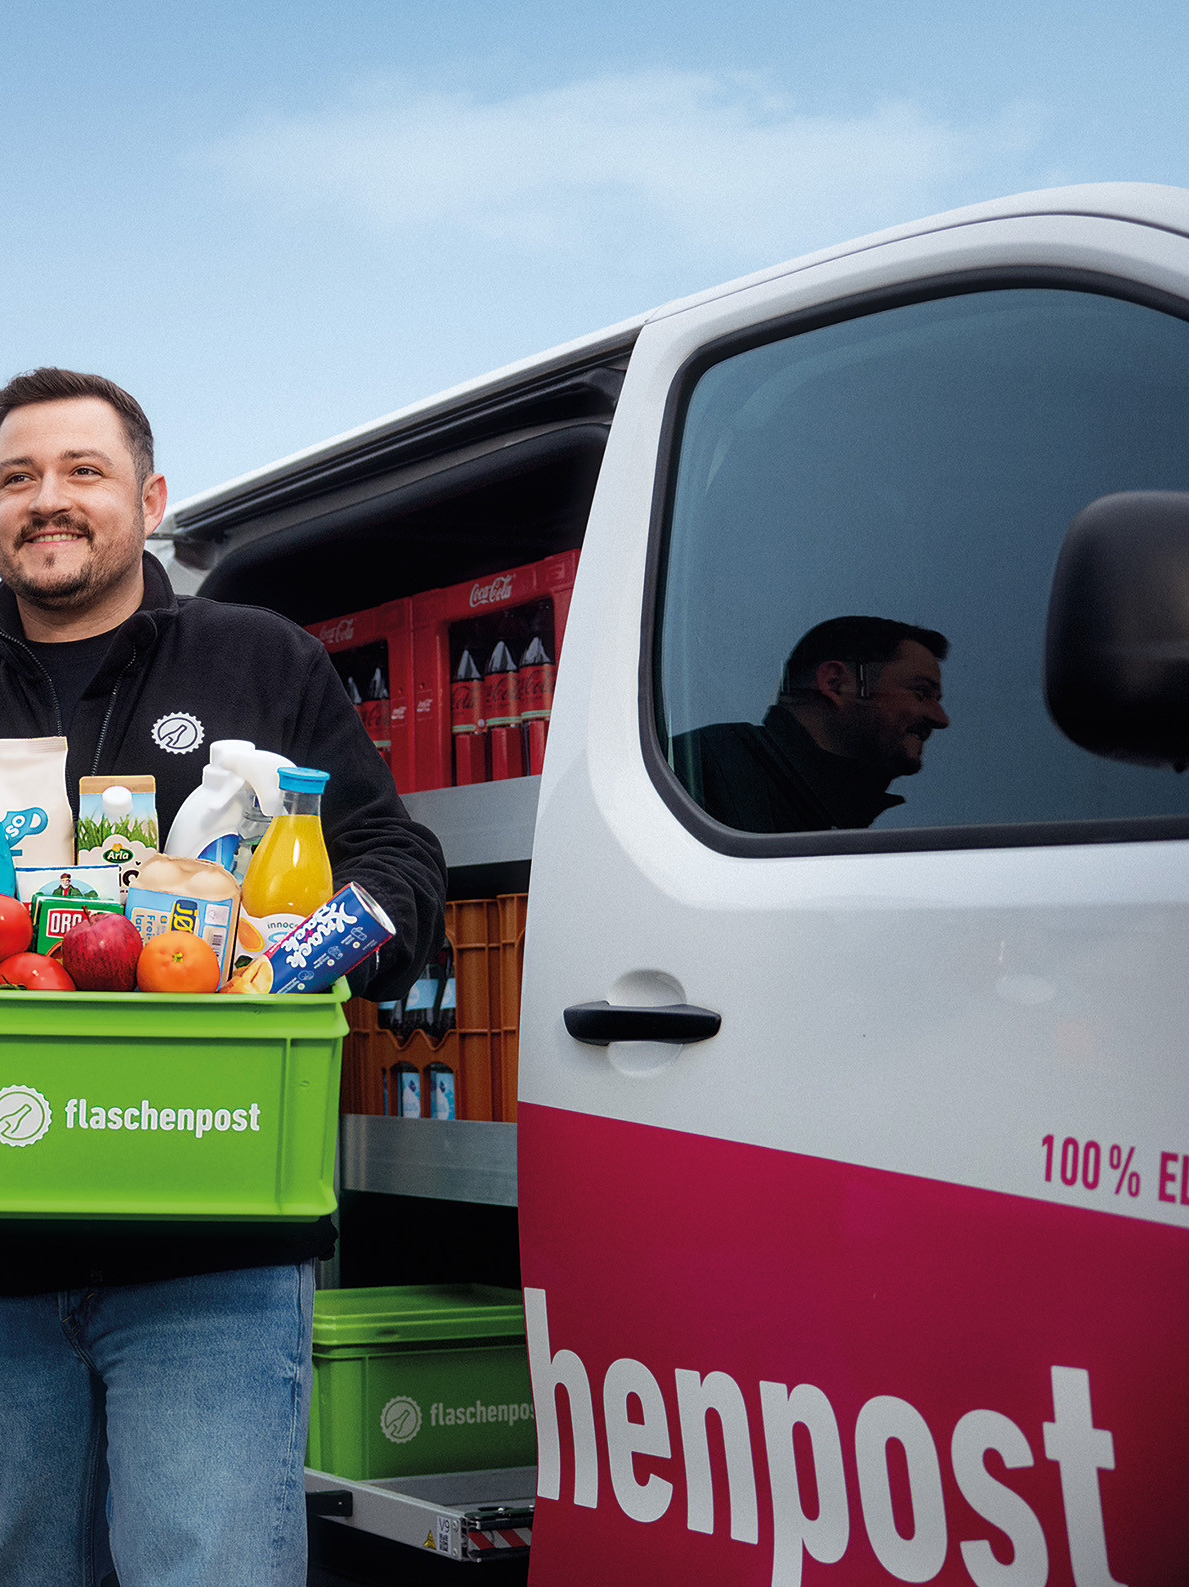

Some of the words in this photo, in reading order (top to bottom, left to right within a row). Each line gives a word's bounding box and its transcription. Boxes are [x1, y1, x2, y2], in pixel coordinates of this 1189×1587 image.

[469, 576, 515, 608] Coca-Cola
[106, 851, 129, 861] Arla
[65, 1098, 261, 1139] flaschenpost
[524, 1286, 1129, 1587] henpost
